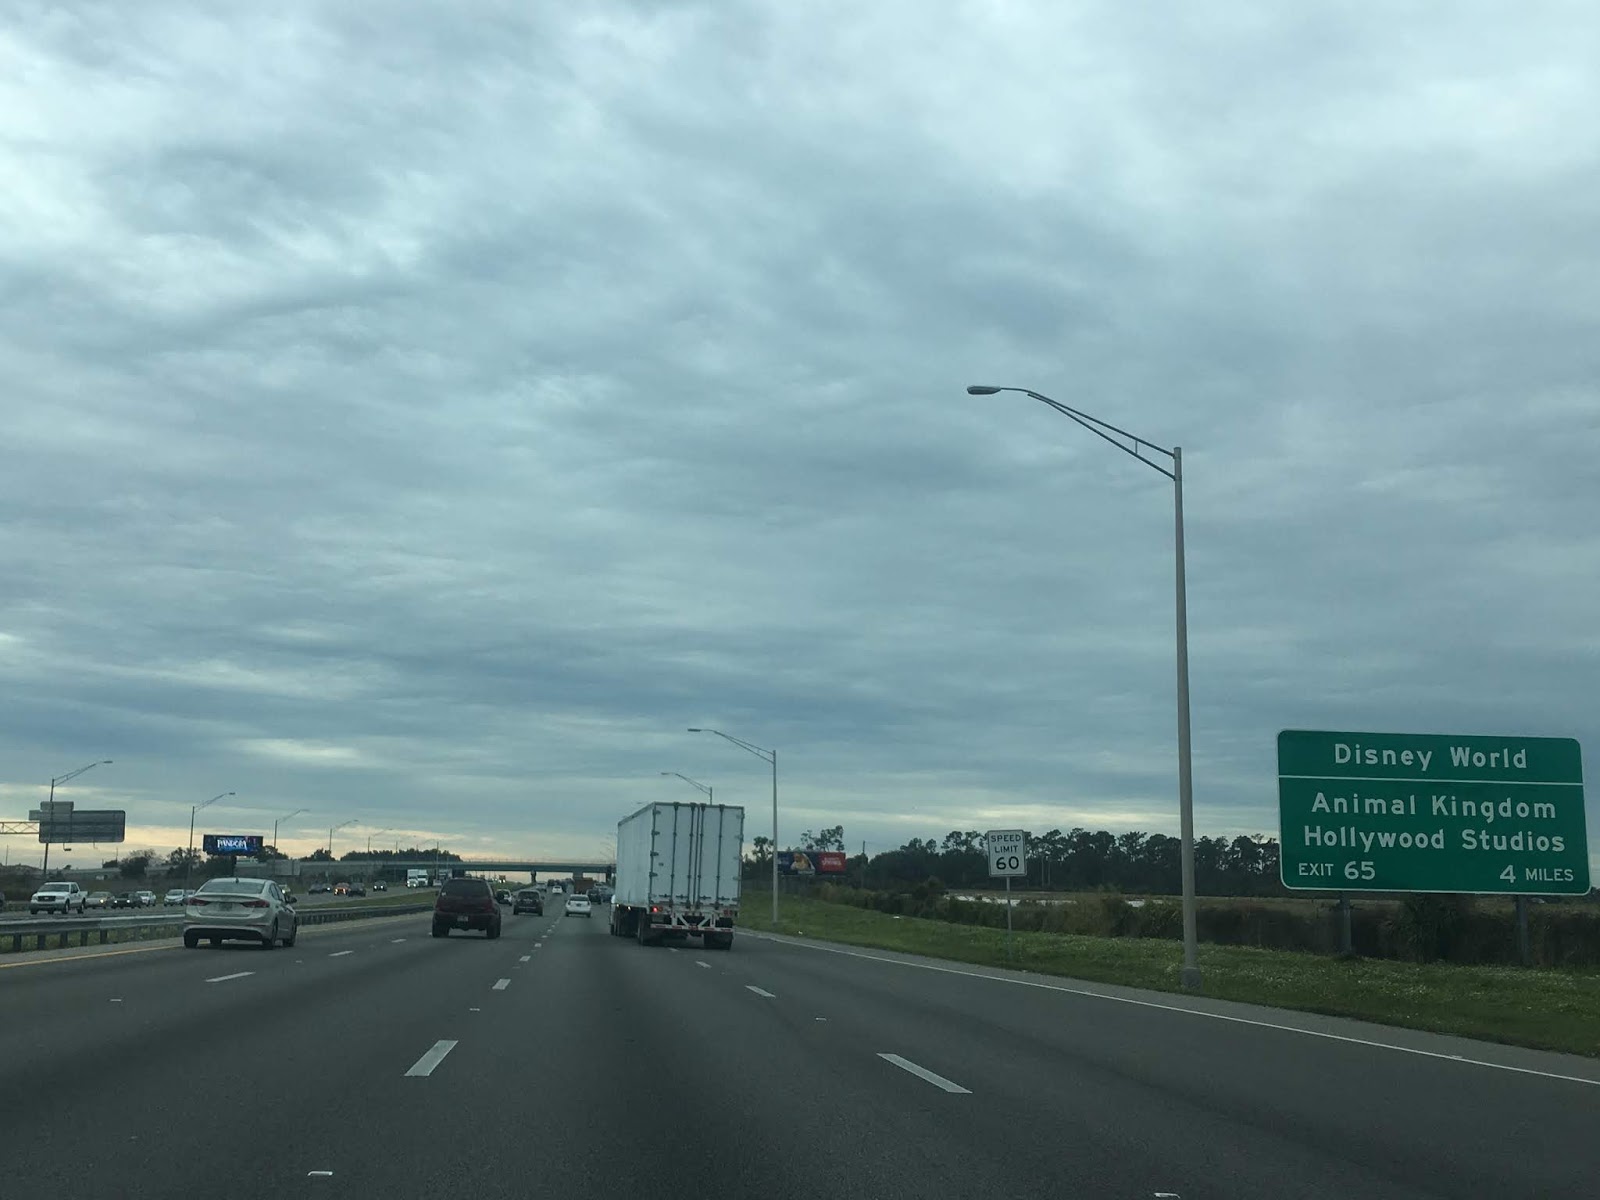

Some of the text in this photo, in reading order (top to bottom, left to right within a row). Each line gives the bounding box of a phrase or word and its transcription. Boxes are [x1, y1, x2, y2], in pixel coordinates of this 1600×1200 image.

[1334, 743, 1527, 772] Disney World
[1311, 792, 1556, 824] Animal Kingdom
[990, 834, 1021, 842] SPEED
[1304, 825, 1565, 853] Hollywood Studios
[994, 845, 1018, 853] LIMIT
[996, 856, 1019, 870] 60
[1298, 860, 1376, 880] EXIT 65
[1499, 864, 1574, 884] 4 MILES
